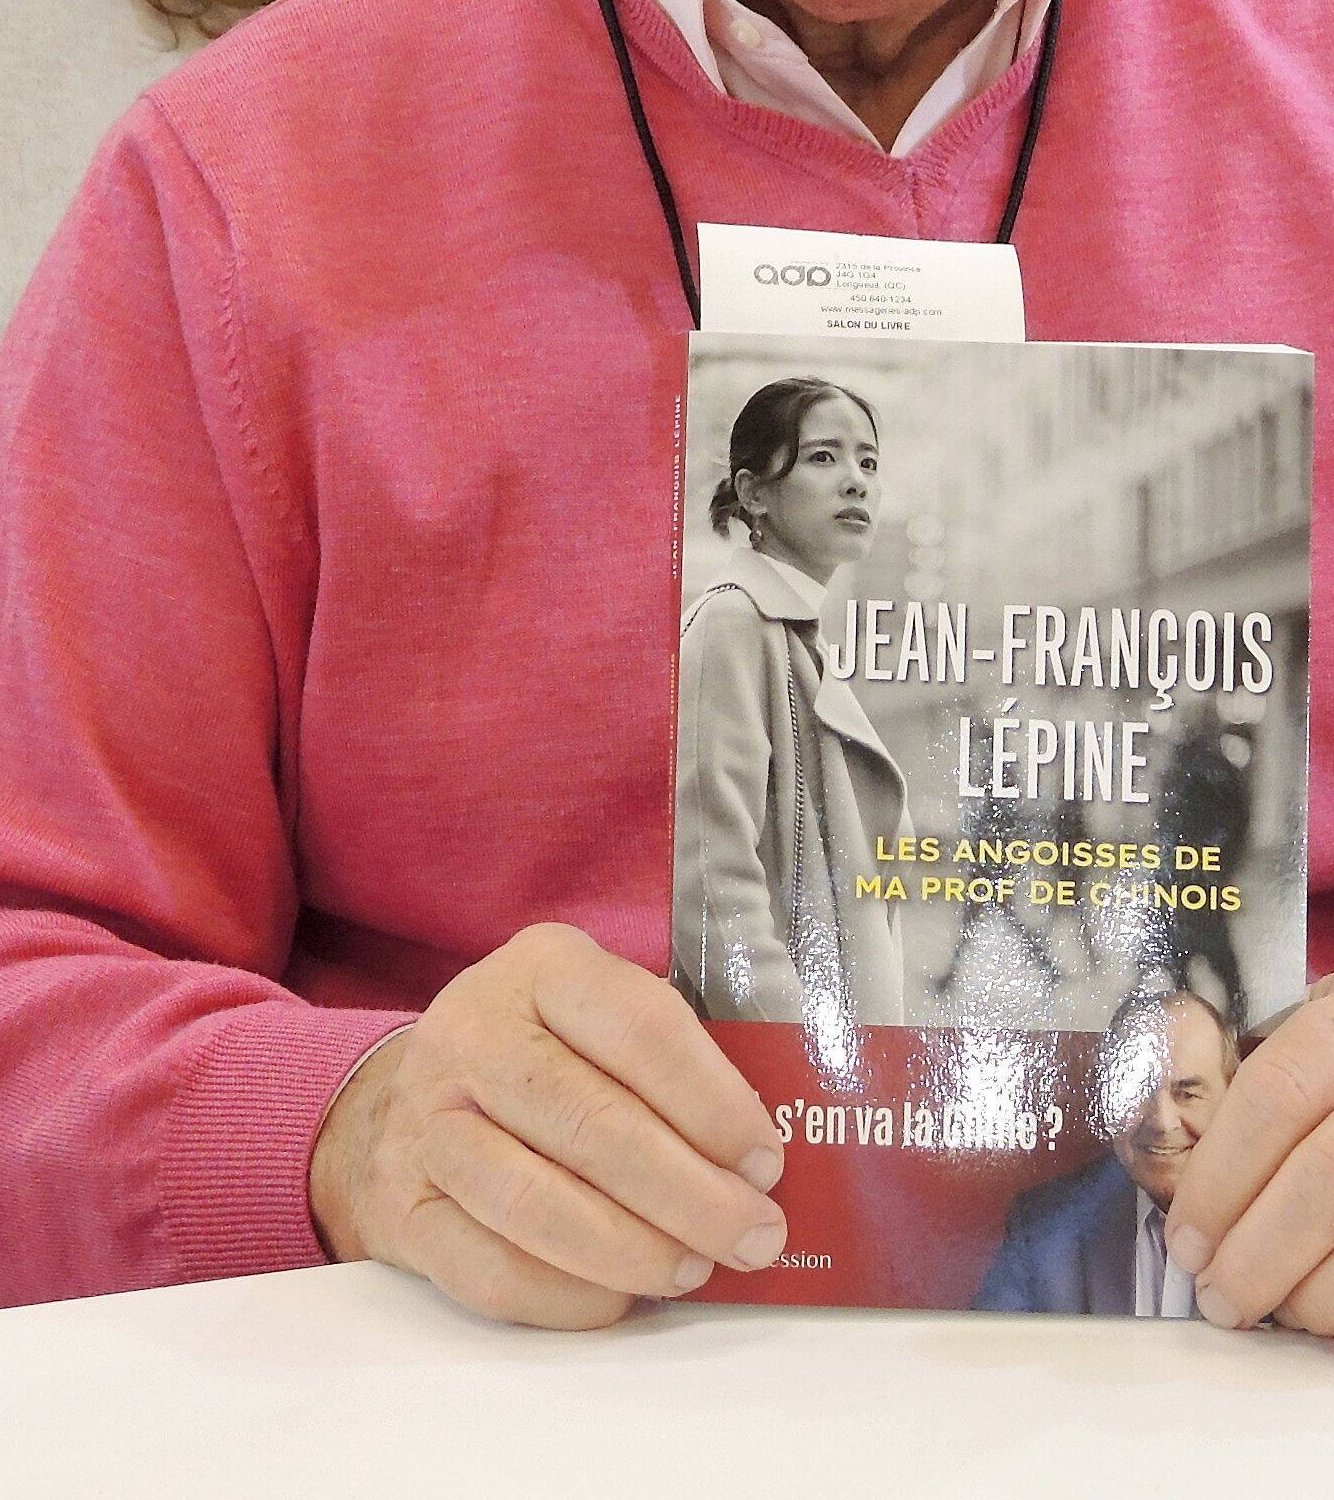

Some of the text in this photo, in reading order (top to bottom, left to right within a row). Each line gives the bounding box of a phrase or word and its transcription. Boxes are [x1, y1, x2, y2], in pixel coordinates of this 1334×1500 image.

[827, 320, 911, 330] SALON DU LIVRE
[829, 598, 1273, 710] JEAN-FRANÇOIS
[958, 698, 1151, 803] LÉPINE
[875, 836, 1222, 871] LES ANGOISSES DE
[855, 875, 907, 900] MA
[921, 877, 1014, 904] PROF
[1030, 880, 1076, 905] DE
[854, 1105, 893, 1146] va
[903, 1102, 933, 1147] la
